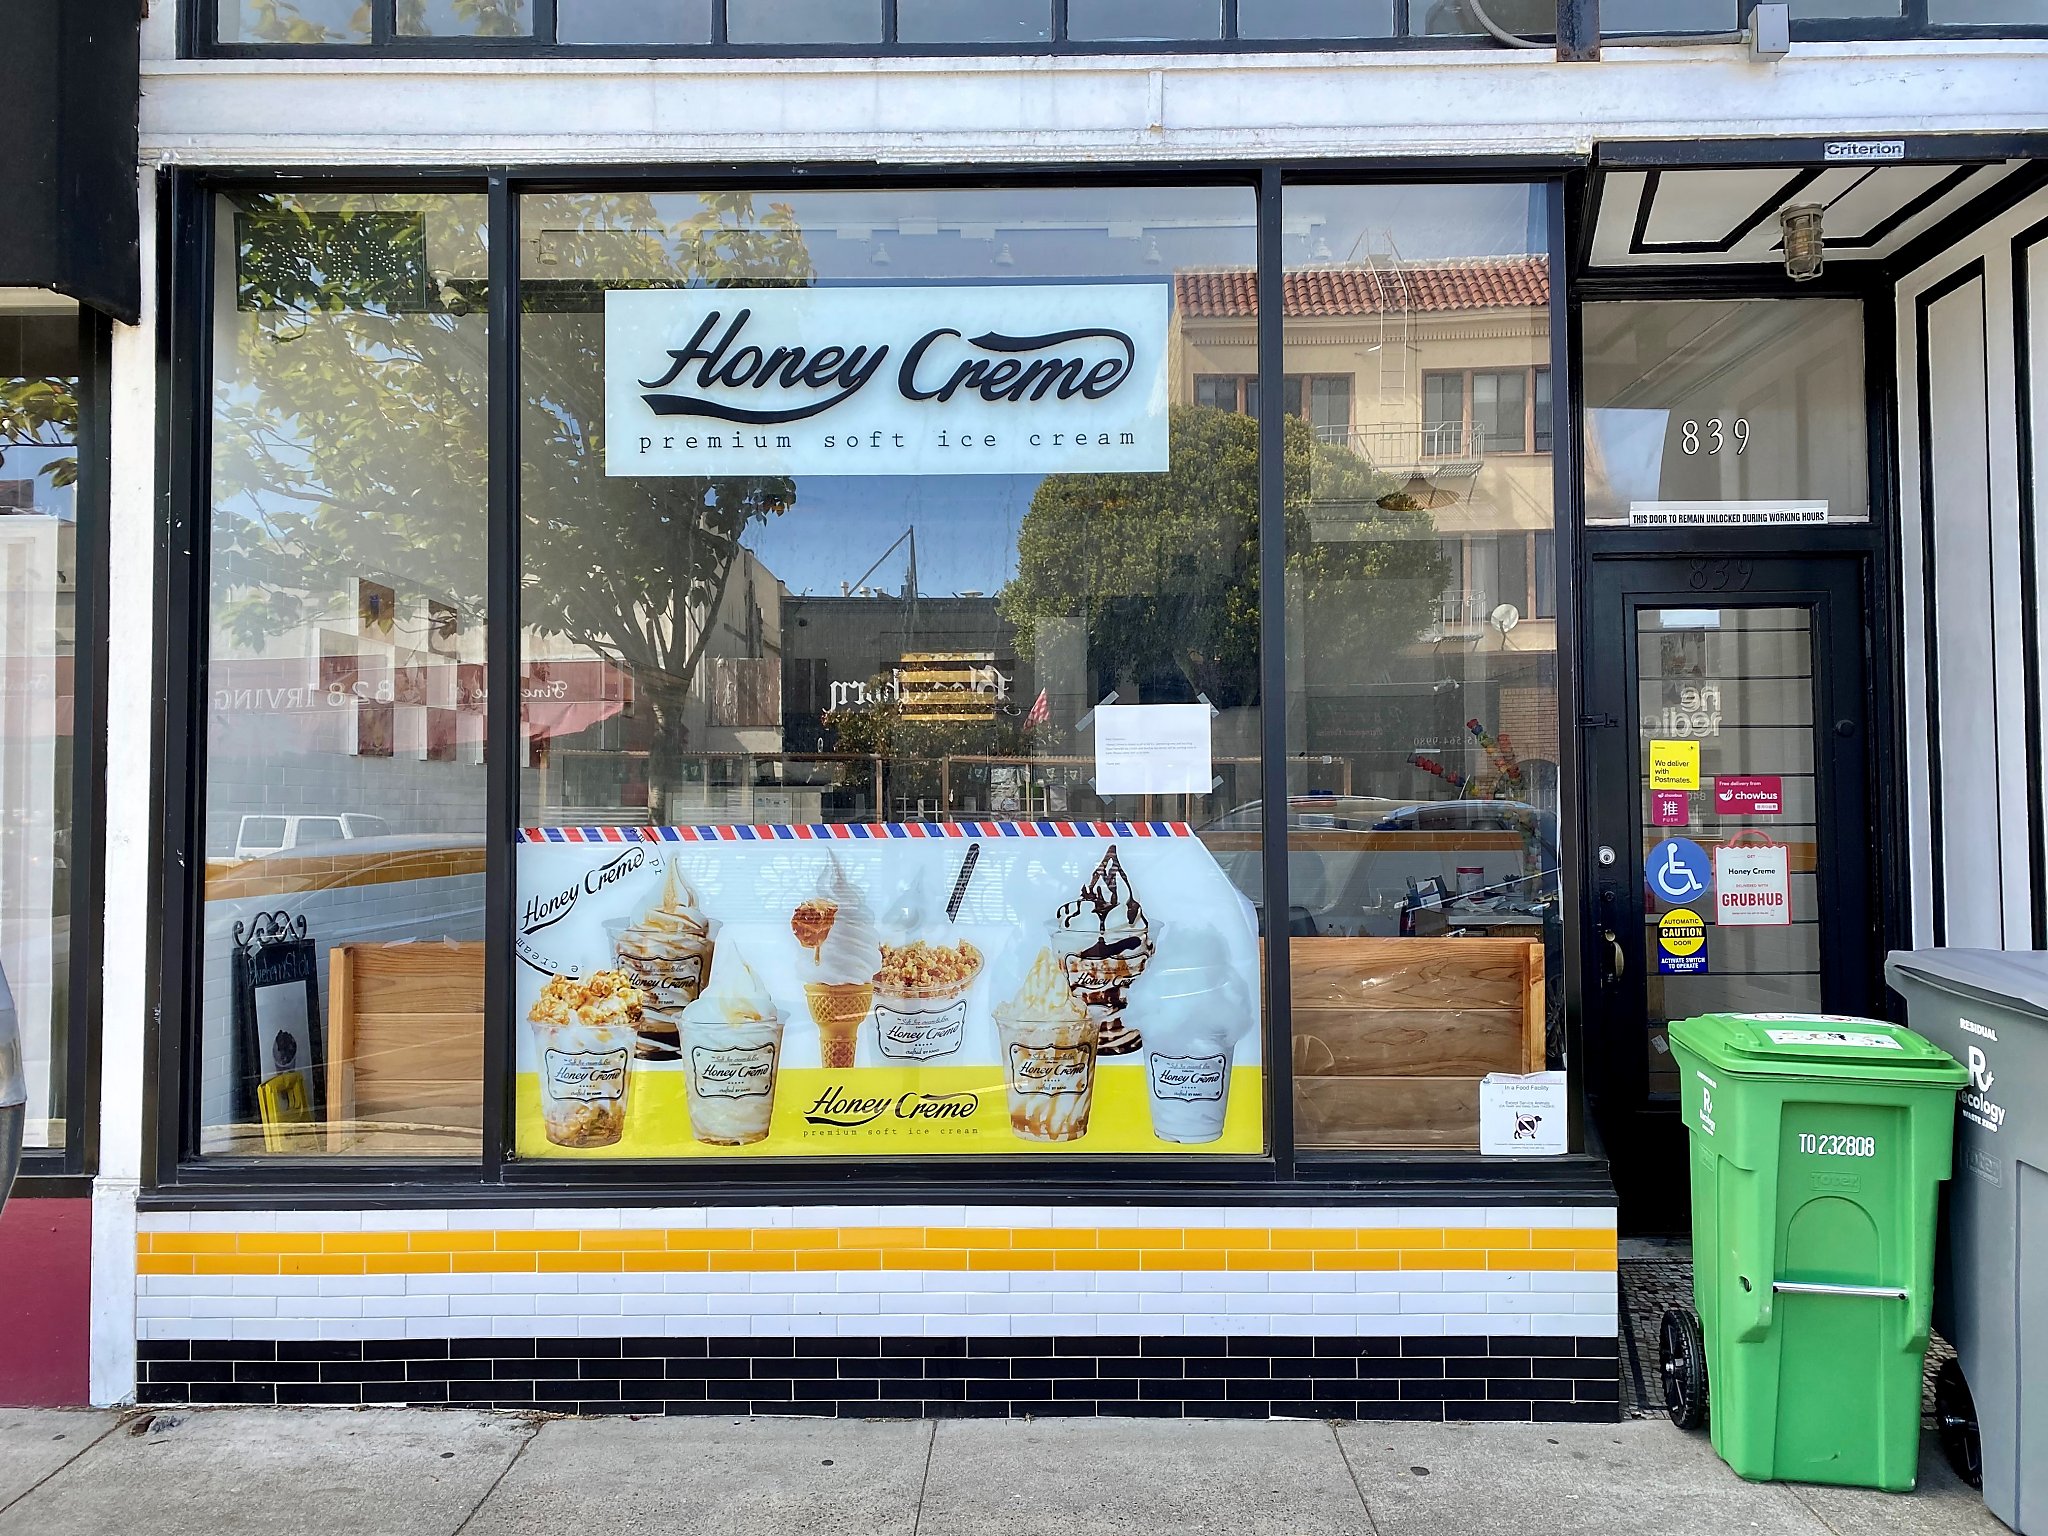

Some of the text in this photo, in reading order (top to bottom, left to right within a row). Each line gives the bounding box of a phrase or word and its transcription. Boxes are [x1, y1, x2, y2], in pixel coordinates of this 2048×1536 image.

[1827, 143, 1902, 155] Criterion
[637, 308, 1136, 425] Honey Creme
[639, 430, 1136, 454] premium soft ice cream
[1682, 418, 1750, 455] 839
[1633, 512, 1825, 524] THIS DOOR TO REMAIN UNLOCKED DURING WORKING HOURS
[1689, 559, 1754, 590] 839
[1735, 790, 1778, 800] chowbus
[1663, 800, 1678, 816] 推
[1728, 867, 1776, 876] Honey Creme
[520, 846, 645, 936] Honey Creme
[1722, 892, 1784, 907] GRUBHUB
[1662, 927, 1703, 937] CAUTION
[628, 972, 696, 991] Honey Creme
[1074, 972, 1111, 989] Honey
[886, 1021, 960, 1043] Honey Creme
[1960, 1018, 1998, 1042] RESIDUAL
[555, 1065, 621, 1084] Honey Creme
[702, 1063, 770, 1081] Honey Creme
[1019, 1061, 1086, 1078] Honey Creme
[1159, 1069, 1221, 1085] Honey Creme
[803, 1085, 979, 1127] Honey Creme
[1958, 1091, 2007, 1127] ecology
[803, 1127, 979, 1137] premium soft ice cream
[1818, 1134, 1875, 1157] 232808
